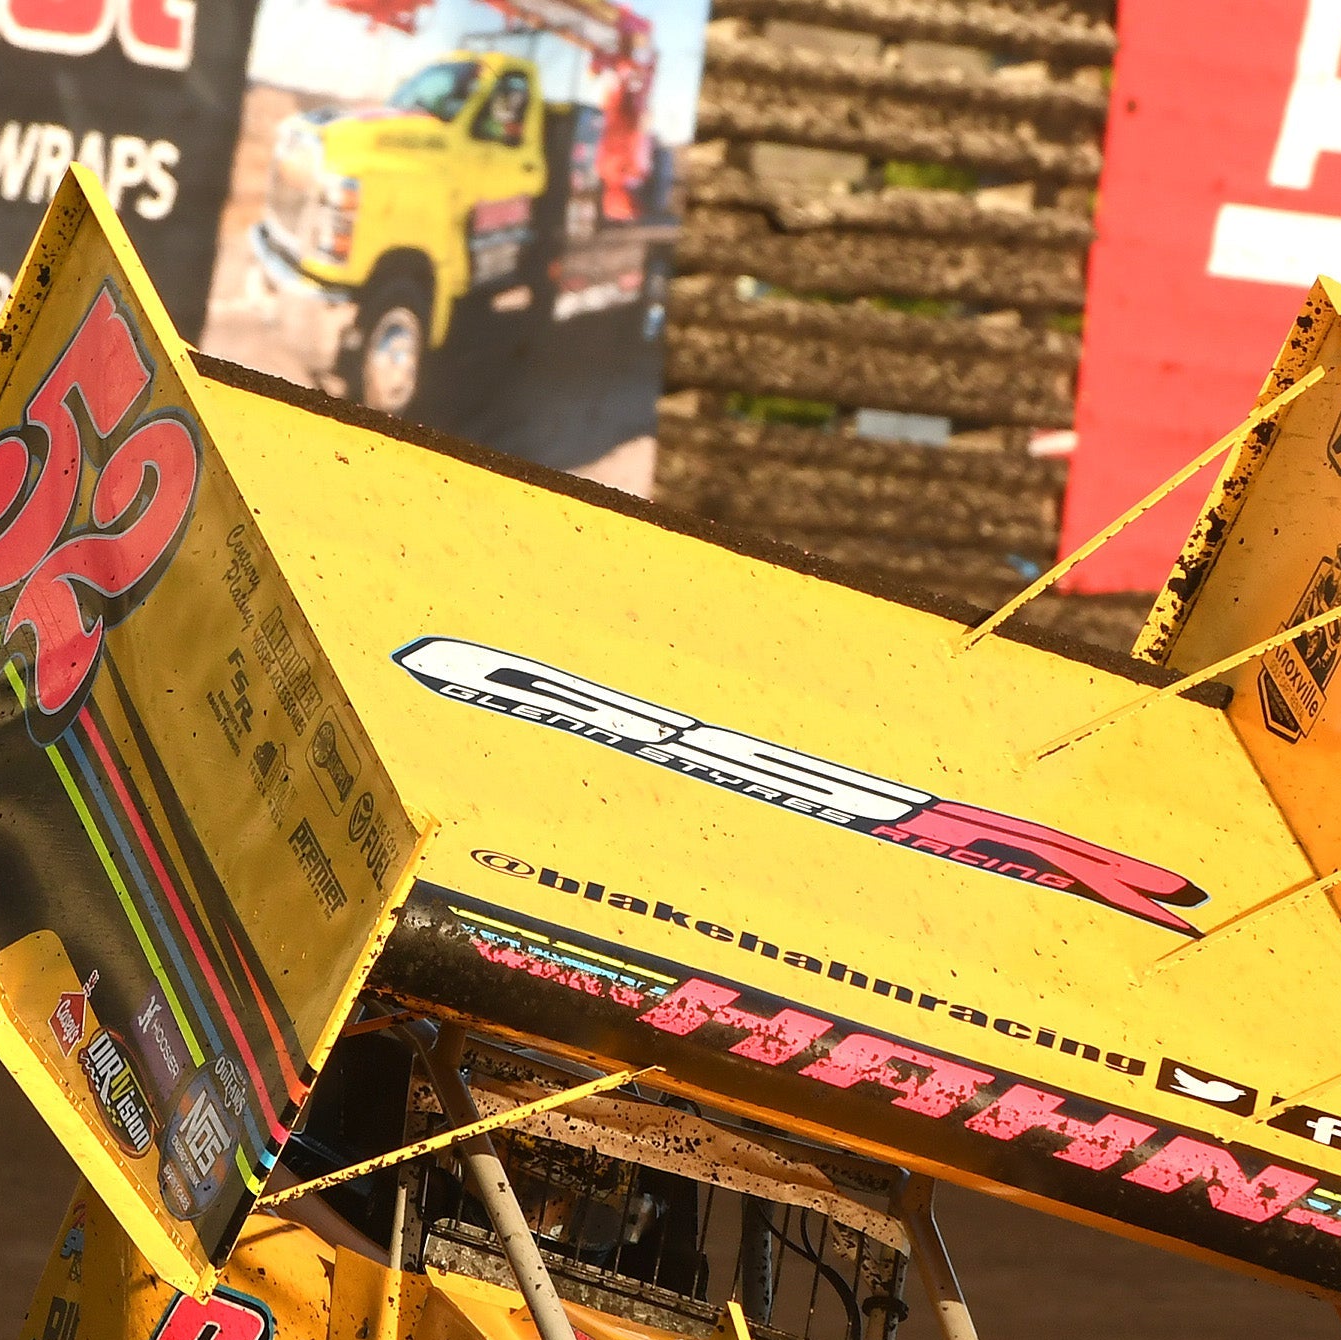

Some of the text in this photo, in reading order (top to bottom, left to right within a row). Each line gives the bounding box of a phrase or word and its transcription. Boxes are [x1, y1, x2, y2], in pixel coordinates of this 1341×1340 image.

[439, 683, 1076, 890] GLENN STYRES RACING
[58, 1000, 84, 1044] Casey's
[471, 849, 1146, 1077] @blakehahnracing
[153, 1020, 179, 1079] HOOSIER
[637, 978, 1319, 1223] HAHN
[179, 1091, 231, 1176] NOS
